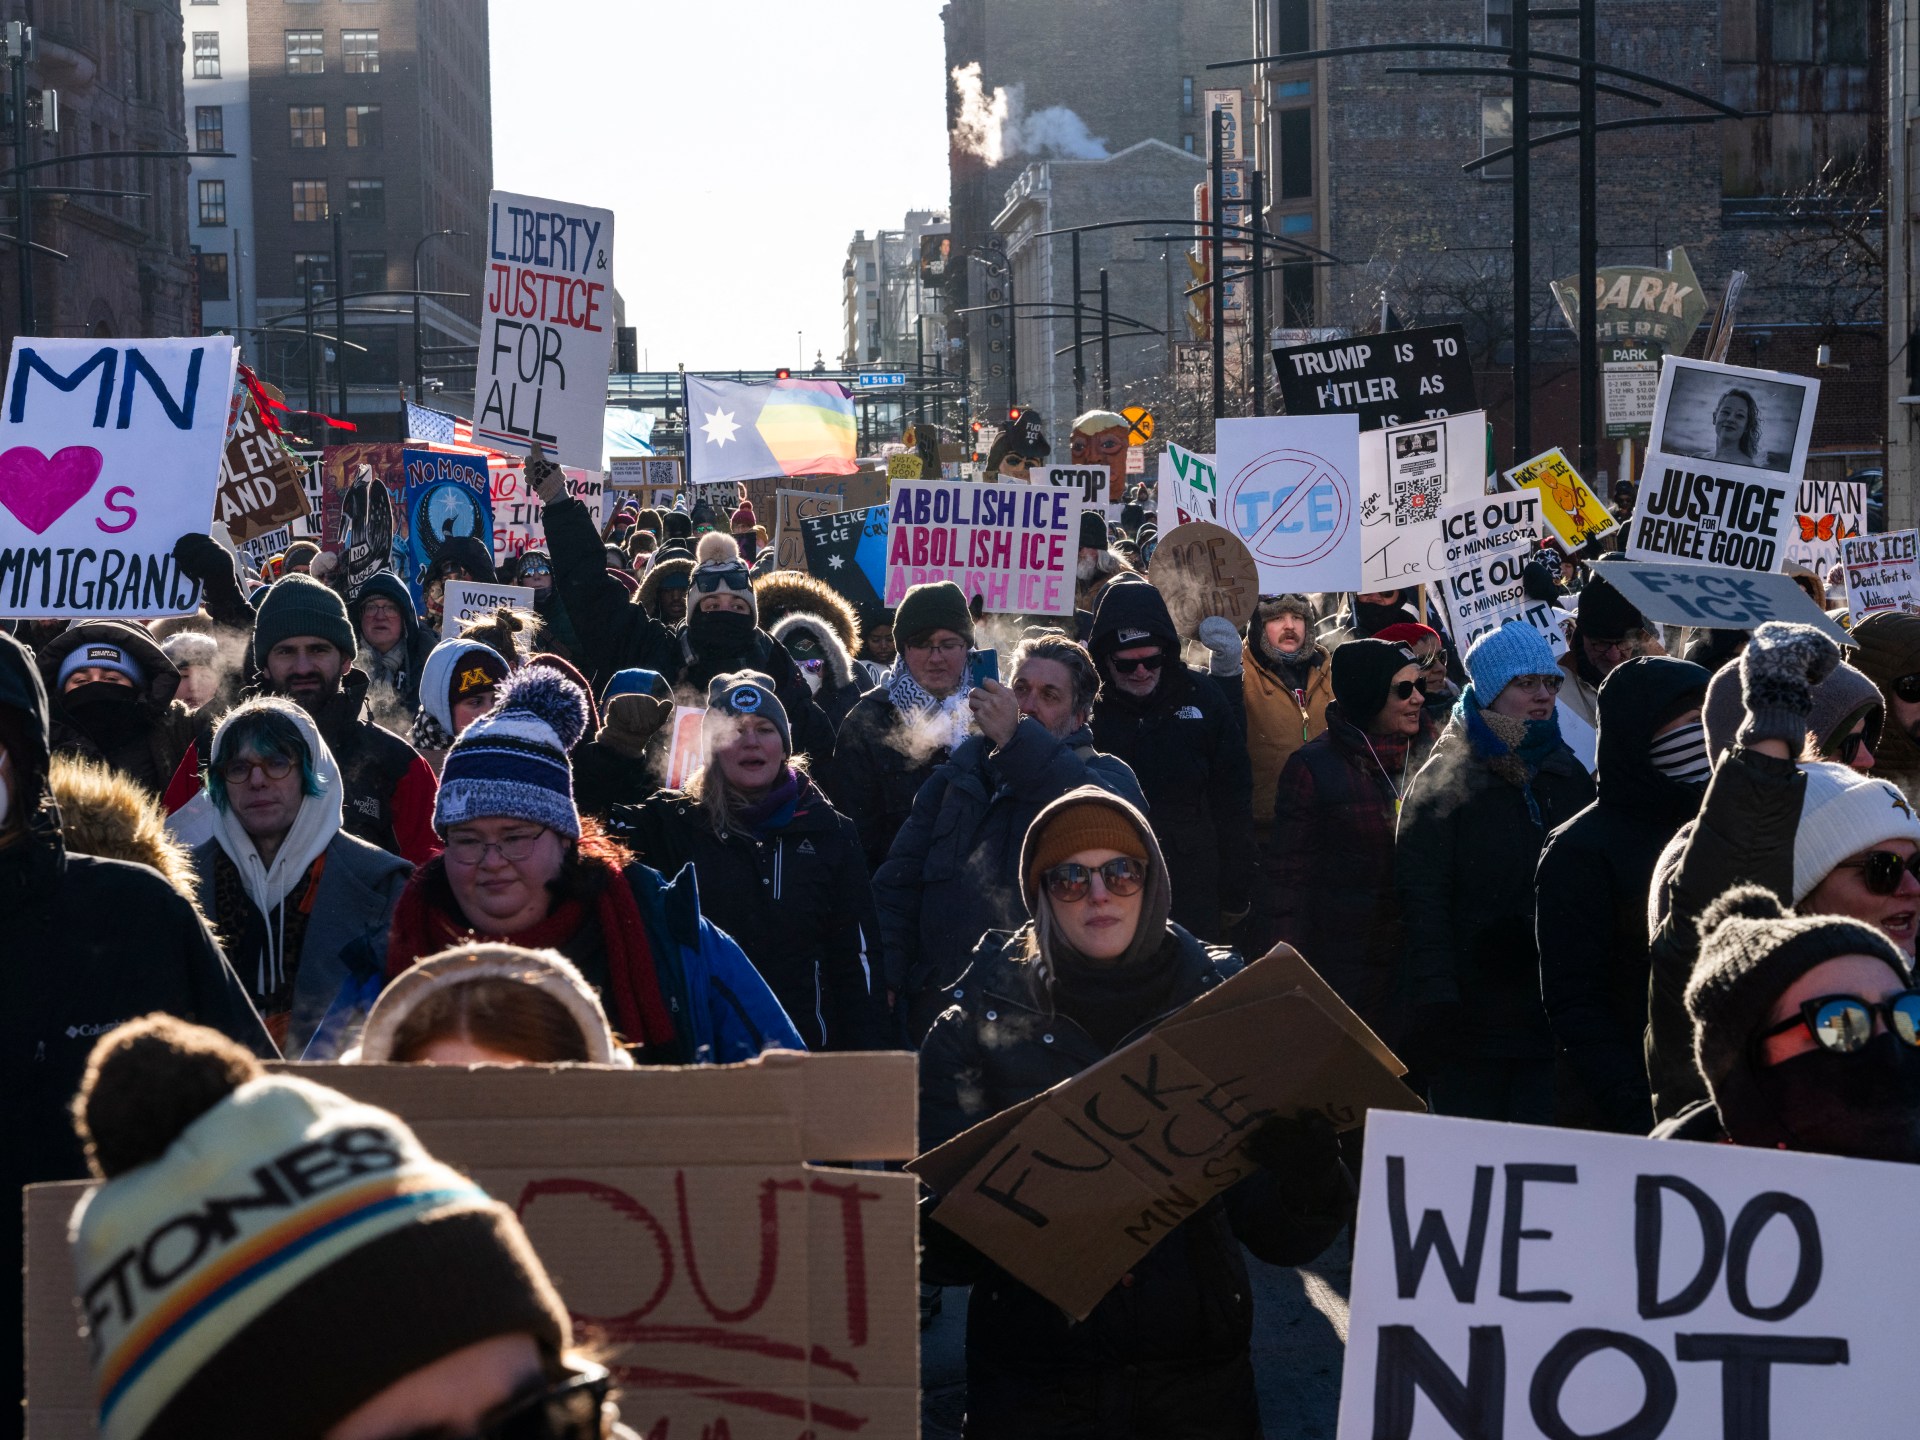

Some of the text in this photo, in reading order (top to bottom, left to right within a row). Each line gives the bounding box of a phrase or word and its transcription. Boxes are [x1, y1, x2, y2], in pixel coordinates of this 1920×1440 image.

[491, 203, 607, 275] LIBERTY &
[489, 264, 604, 332] JUSTICE
[1596, 321, 1667, 338] HERE
[492, 318, 565, 390] FOR
[1289, 338, 1458, 376] TRUMP IS TO
[1613, 349, 1648, 361] PARK
[9, 347, 205, 430] MN
[862, 375, 902, 384] N 5th St
[1420, 375, 1445, 396] AS
[480, 380, 557, 443] ALL
[1142, 421, 1150, 430] R
[407, 458, 486, 494] NO MORE
[892, 467, 916, 477] GOOD
[1549, 461, 1570, 477] ICE
[1050, 469, 1106, 503] STOP
[891, 488, 1070, 530] ABOLISH ICE
[1235, 484, 1333, 536] ICE
[1364, 505, 1380, 520] me
[1647, 468, 1785, 537] JUSTICE
[808, 520, 820, 531] I
[832, 509, 866, 527] LIKE
[1442, 498, 1538, 543] ICE OUT
[1701, 518, 1717, 530] FOR
[275, 530, 288, 551] TO
[353, 546, 366, 559] NO
[779, 536, 806, 567] OU
[815, 527, 850, 546] ICE
[889, 526, 1067, 571] ABOLISH ICE
[1446, 546, 1461, 561] OF
[1464, 528, 1538, 556] MINNESOTA
[1570, 535, 1582, 546] EL
[1636, 516, 1704, 560] RENEE
[1708, 530, 1776, 572] GOOD
[1845, 534, 1918, 564] FUCK ICE!
[352, 564, 374, 584] MORE
[1172, 537, 1235, 587] ICE
[1016, 574, 1063, 612] ICE
[1450, 567, 1485, 600] ICE
[1850, 569, 1912, 589] Death first to
[462, 592, 516, 608] WORST
[1459, 585, 1523, 618] OF MINNESO
[1666, 594, 1777, 623] ICE
[1860, 590, 1912, 608] Vultures and
[459, 667, 493, 693] M
[353, 800, 380, 810] NORTH
[358, 807, 380, 819] FACE
[366, 796, 380, 806] THE
[975, 1053, 1203, 1228] FUCK
[1131, 1075, 1278, 1177] ICE
[1124, 1185, 1200, 1246] MN
[1386, 1154, 1823, 1321] WE DO
[516, 1170, 882, 1347] OUT
[1371, 1324, 1850, 1440] NOT
